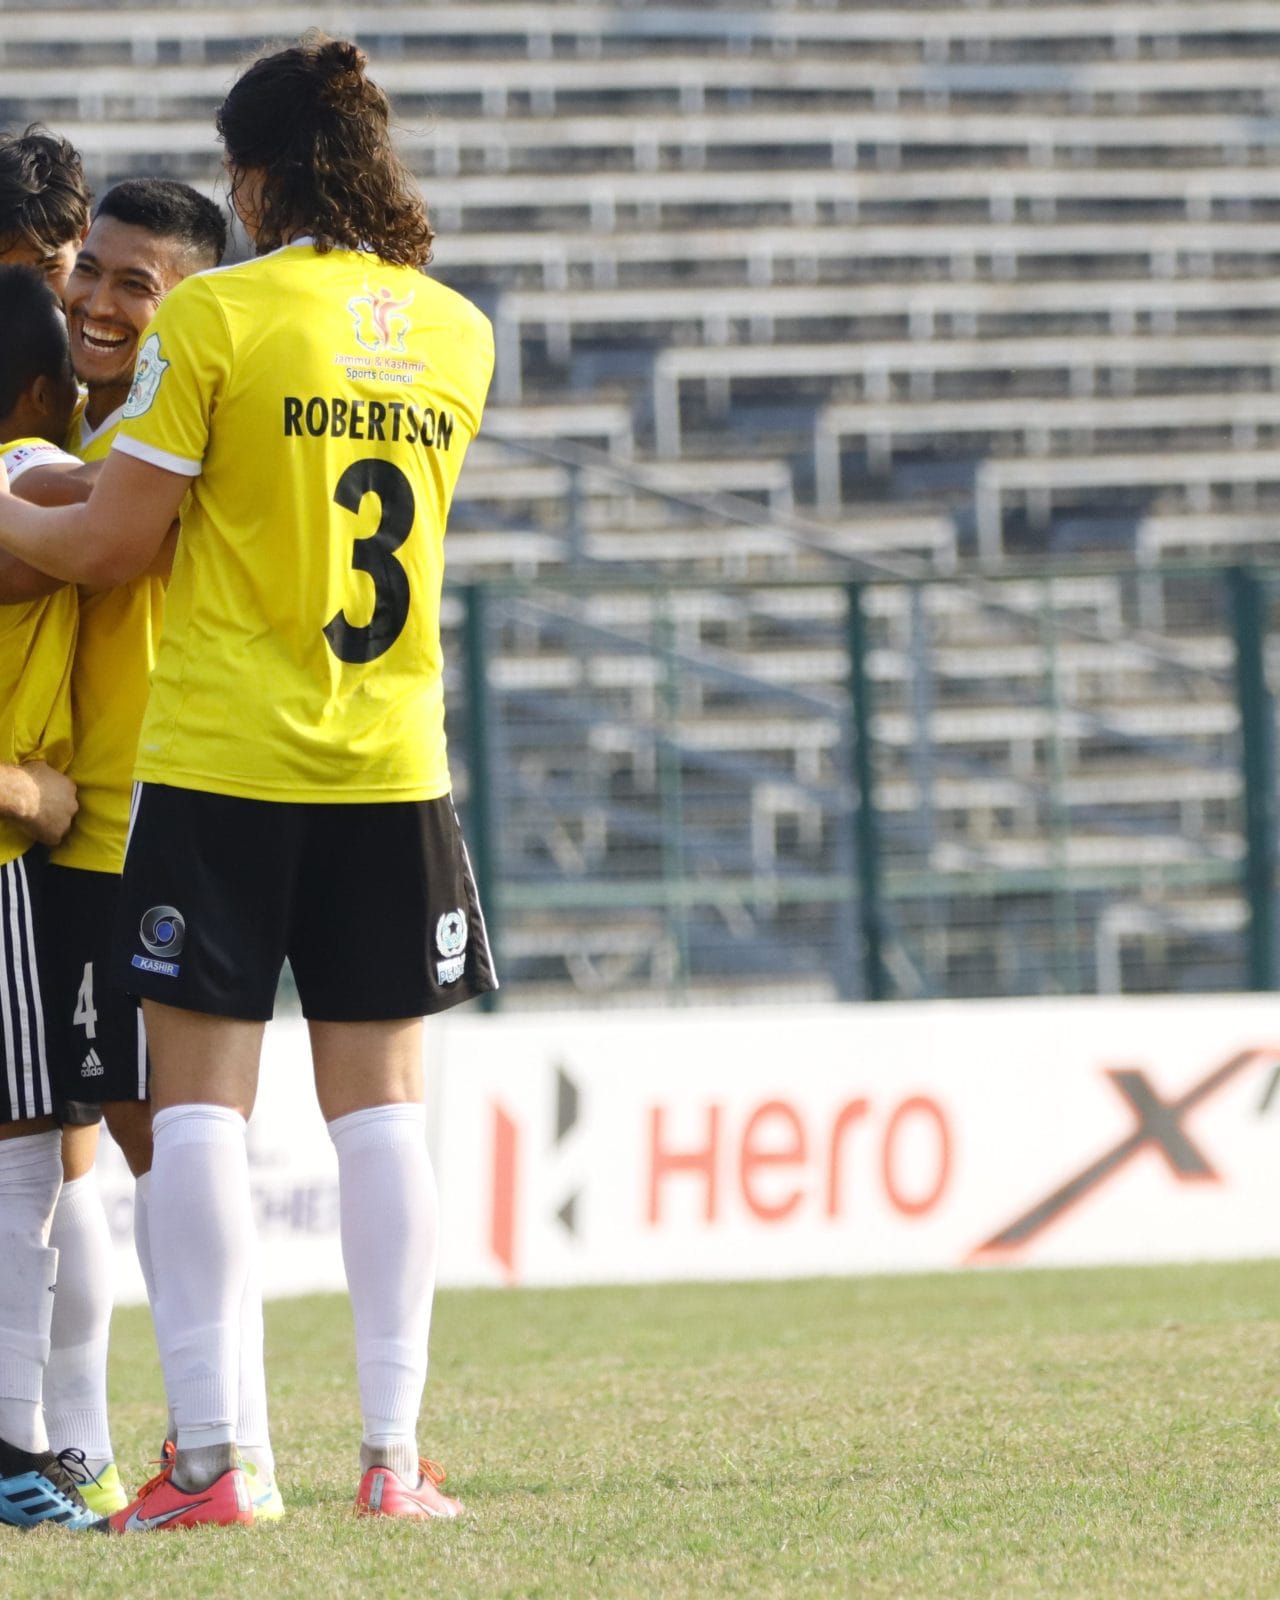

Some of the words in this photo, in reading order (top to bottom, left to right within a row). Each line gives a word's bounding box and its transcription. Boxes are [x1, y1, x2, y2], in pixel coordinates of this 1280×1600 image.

[385, 358, 425, 371] Kashmir
[346, 368, 376, 379] Sports
[379, 371, 413, 383] Council
[283, 397, 454, 451] ROBERTSON
[323, 458, 416, 664] 3
[140, 959, 175, 974] KASHIR
[73, 961, 98, 1039] 4
[81, 1066, 104, 1078] adidas
